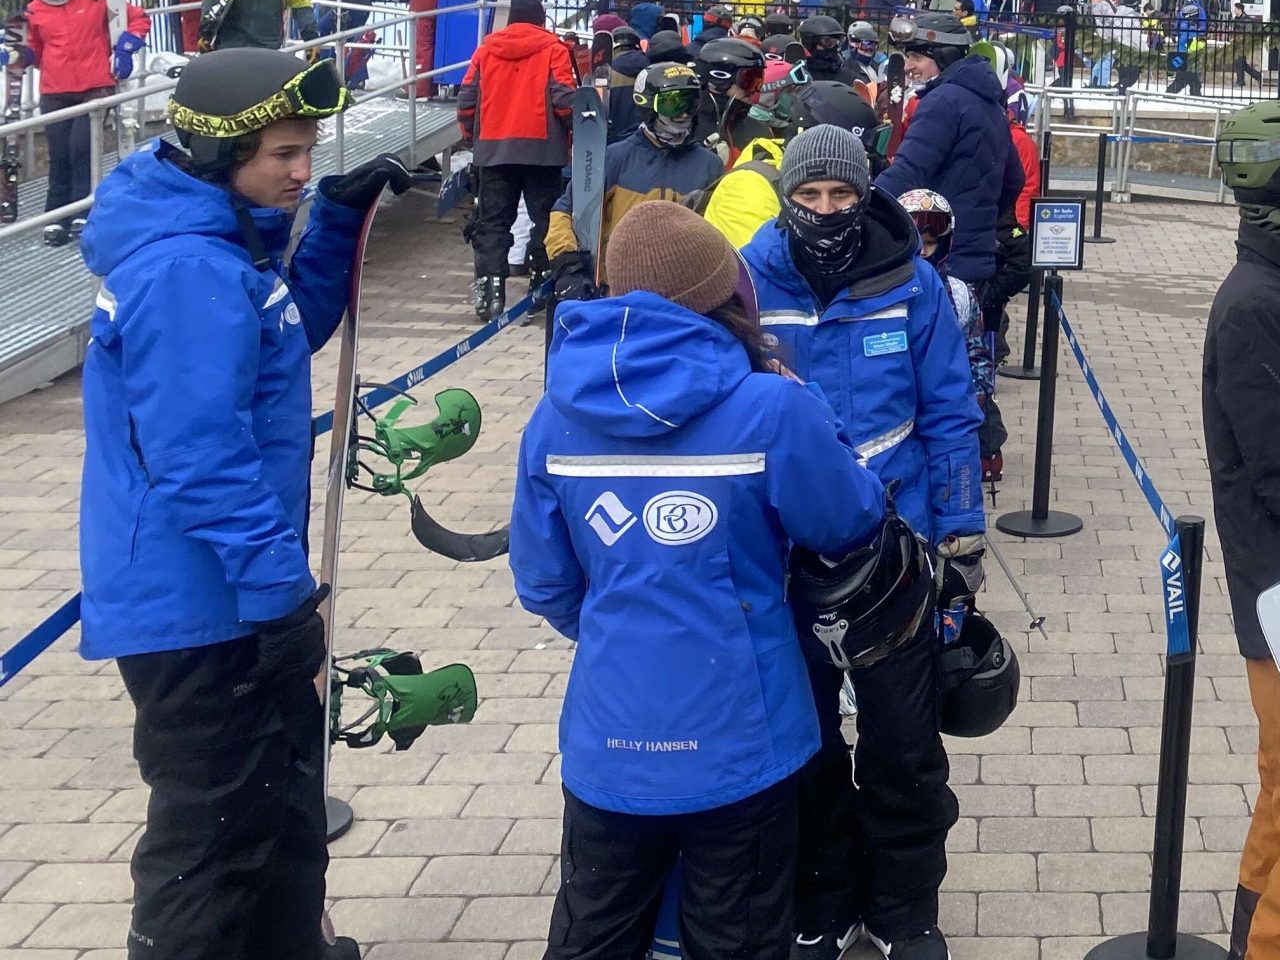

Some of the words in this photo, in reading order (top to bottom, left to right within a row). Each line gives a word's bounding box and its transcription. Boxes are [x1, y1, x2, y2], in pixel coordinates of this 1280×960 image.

[1166, 571, 1184, 620] VAIL
[607, 738, 642, 751] HELLY
[646, 740, 698, 752] HANSEN
